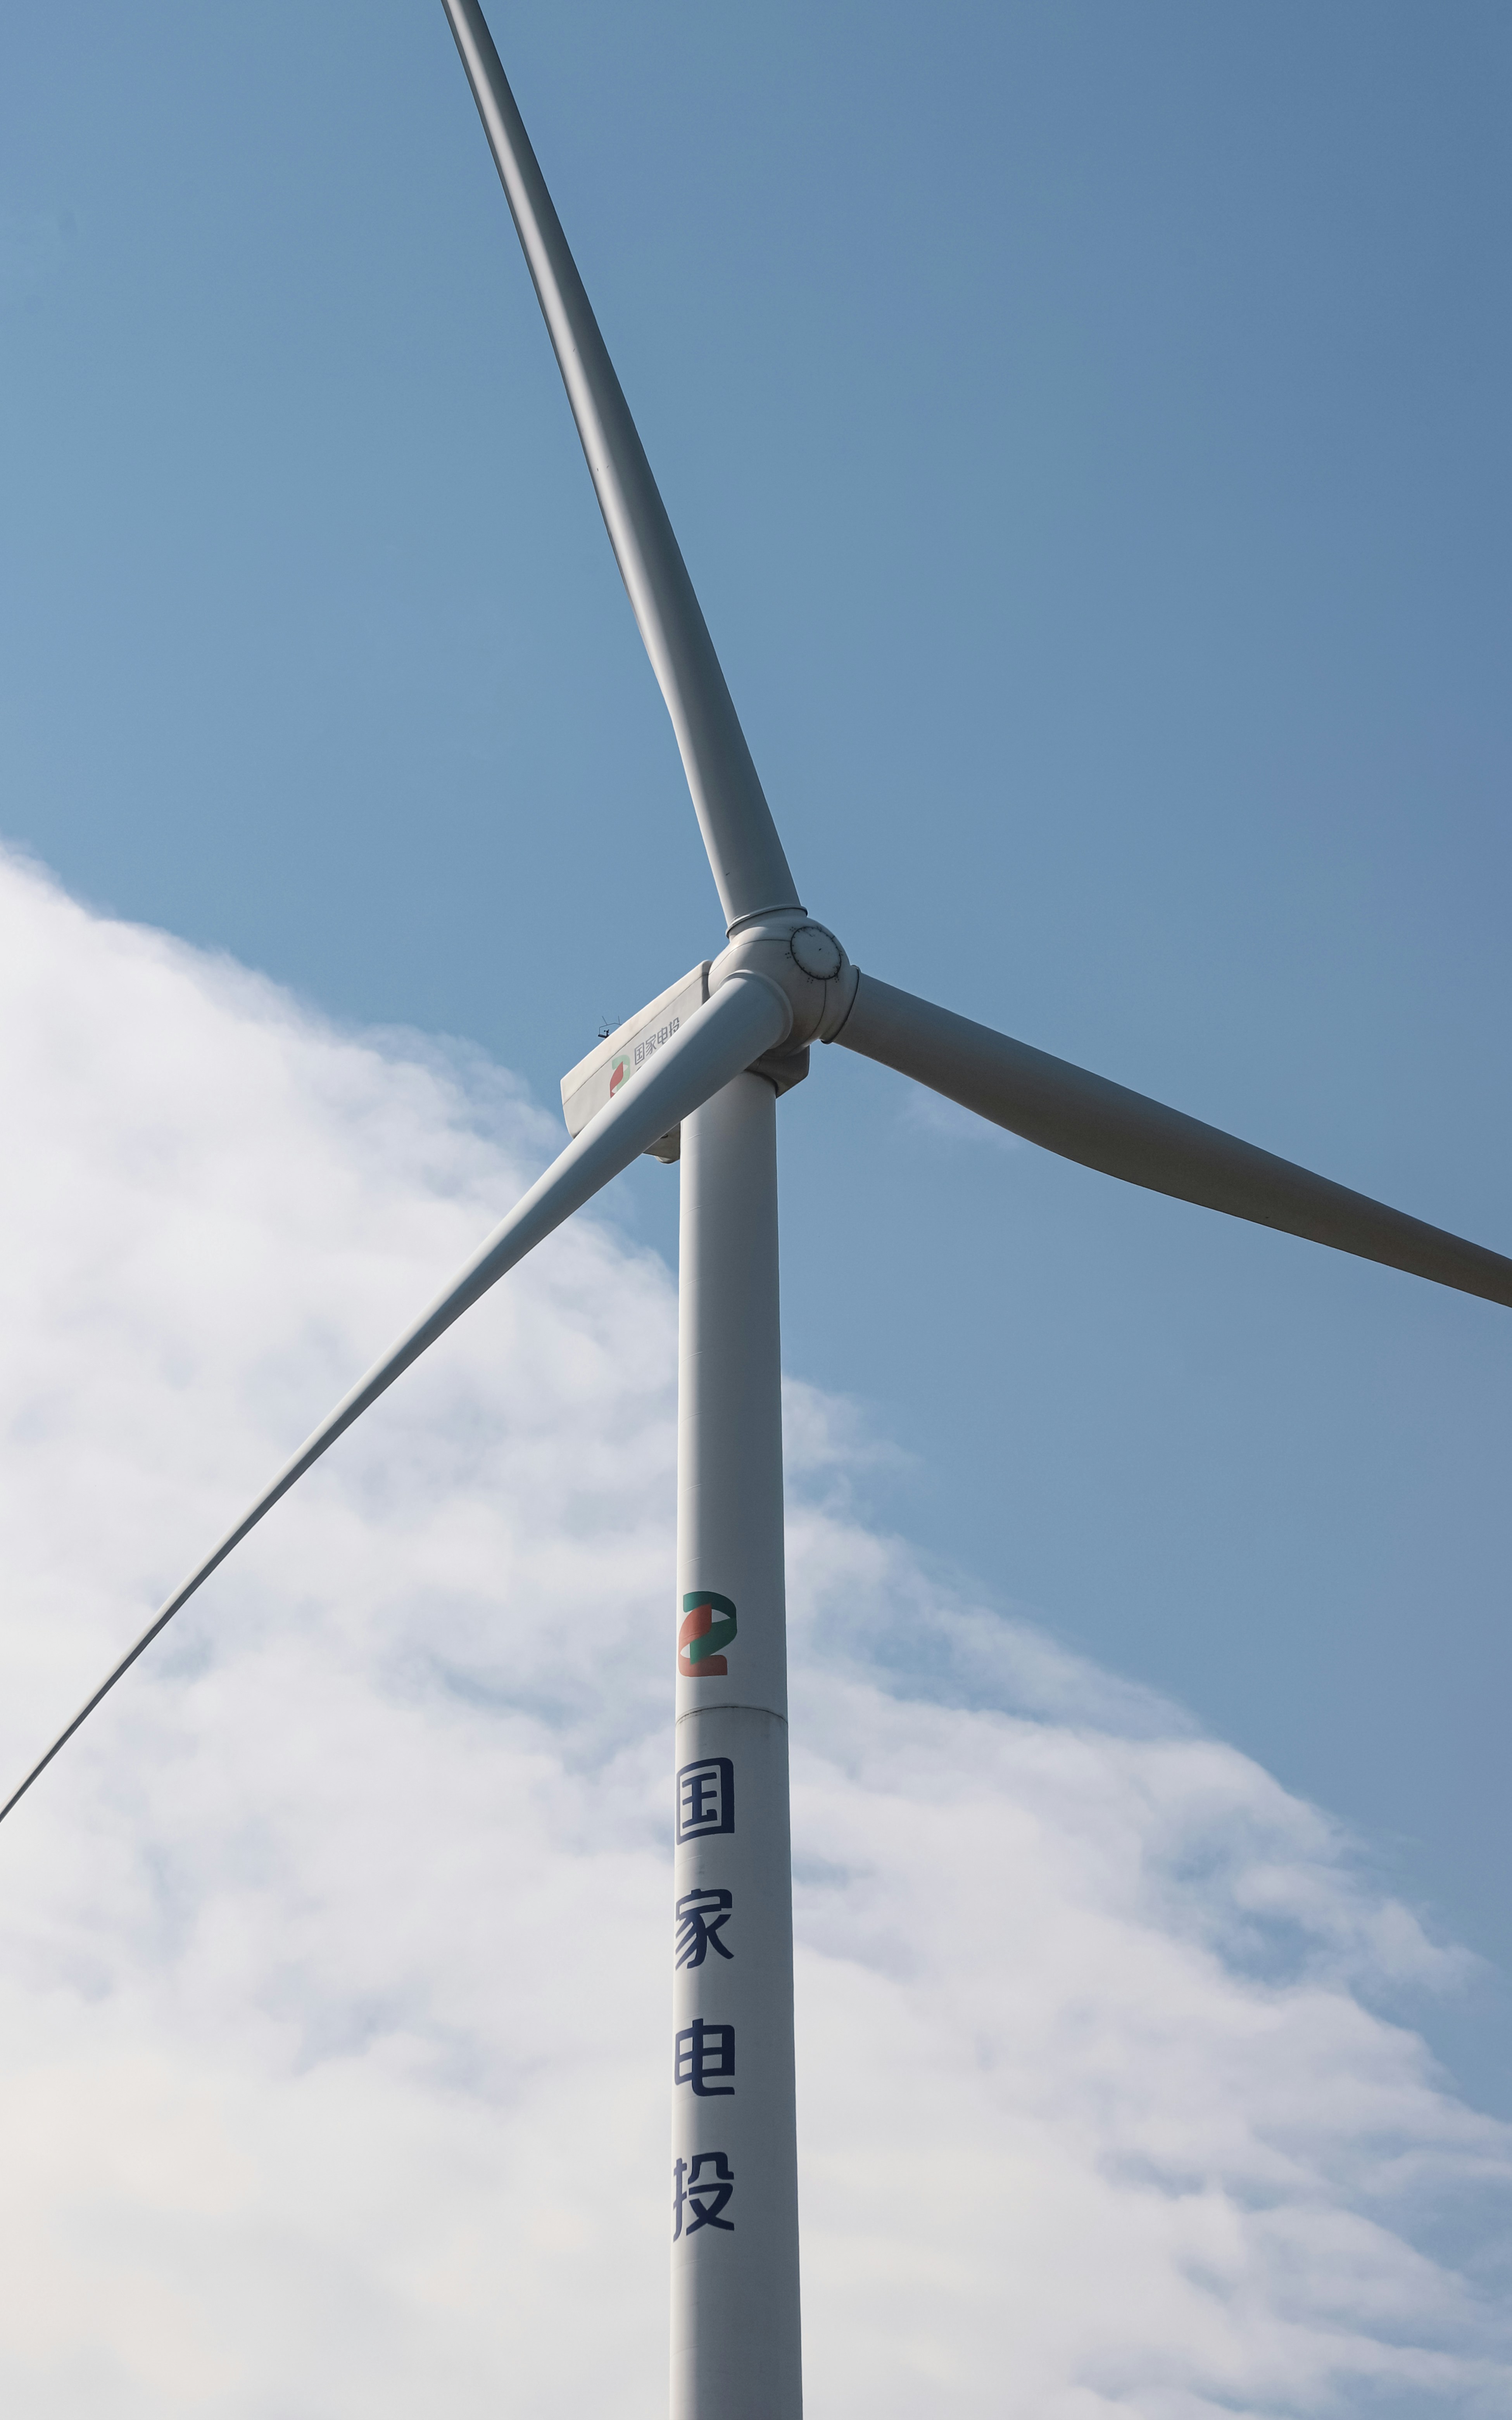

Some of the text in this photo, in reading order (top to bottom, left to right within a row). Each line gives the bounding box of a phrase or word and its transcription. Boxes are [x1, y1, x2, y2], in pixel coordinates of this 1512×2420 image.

[634, 1017, 680, 1065] 国家电投
[673, 1757, 735, 2243] 国家电投
